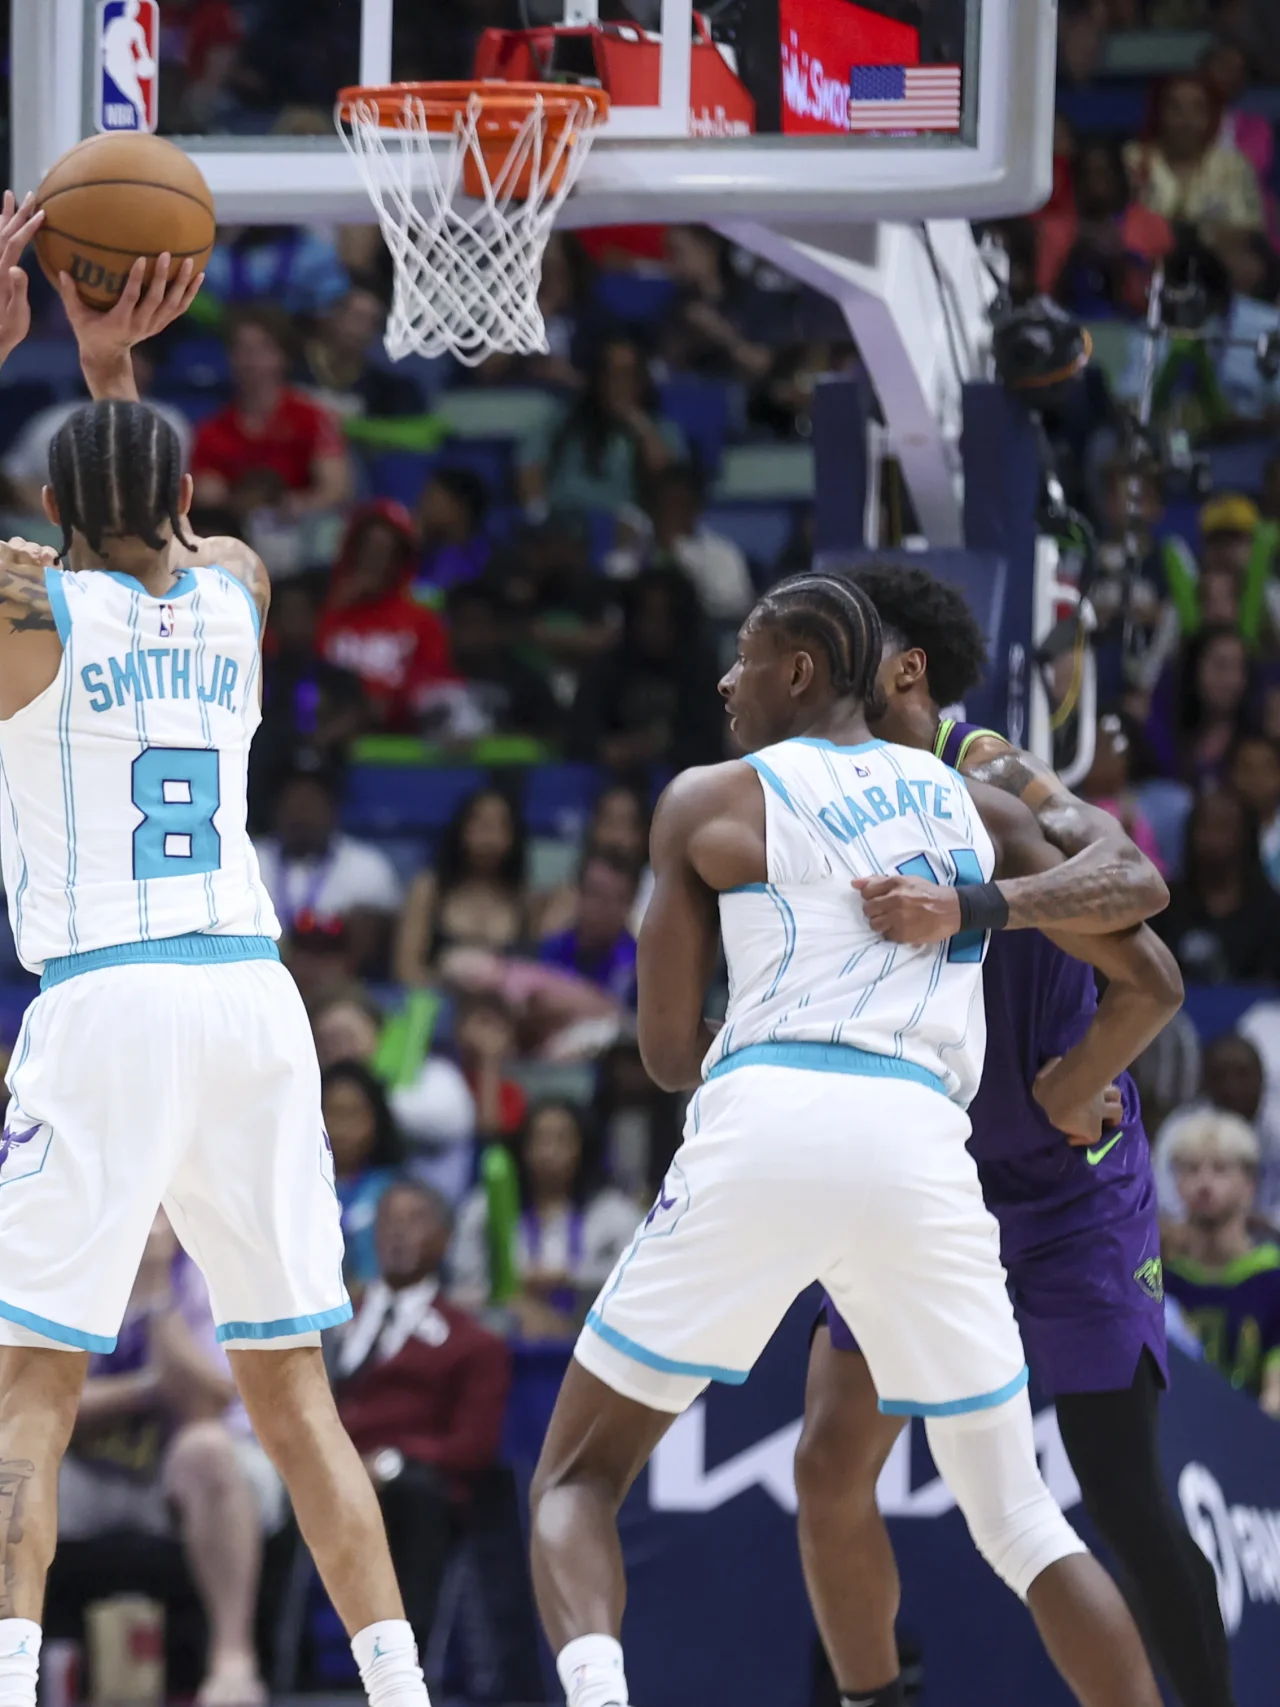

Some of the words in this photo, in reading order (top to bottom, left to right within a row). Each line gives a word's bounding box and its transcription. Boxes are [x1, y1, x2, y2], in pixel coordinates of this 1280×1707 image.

[105, 104, 136, 127] NBA
[81, 648, 190, 713] SMITH
[199, 654, 238, 714] JR.
[131, 746, 221, 881] 8
